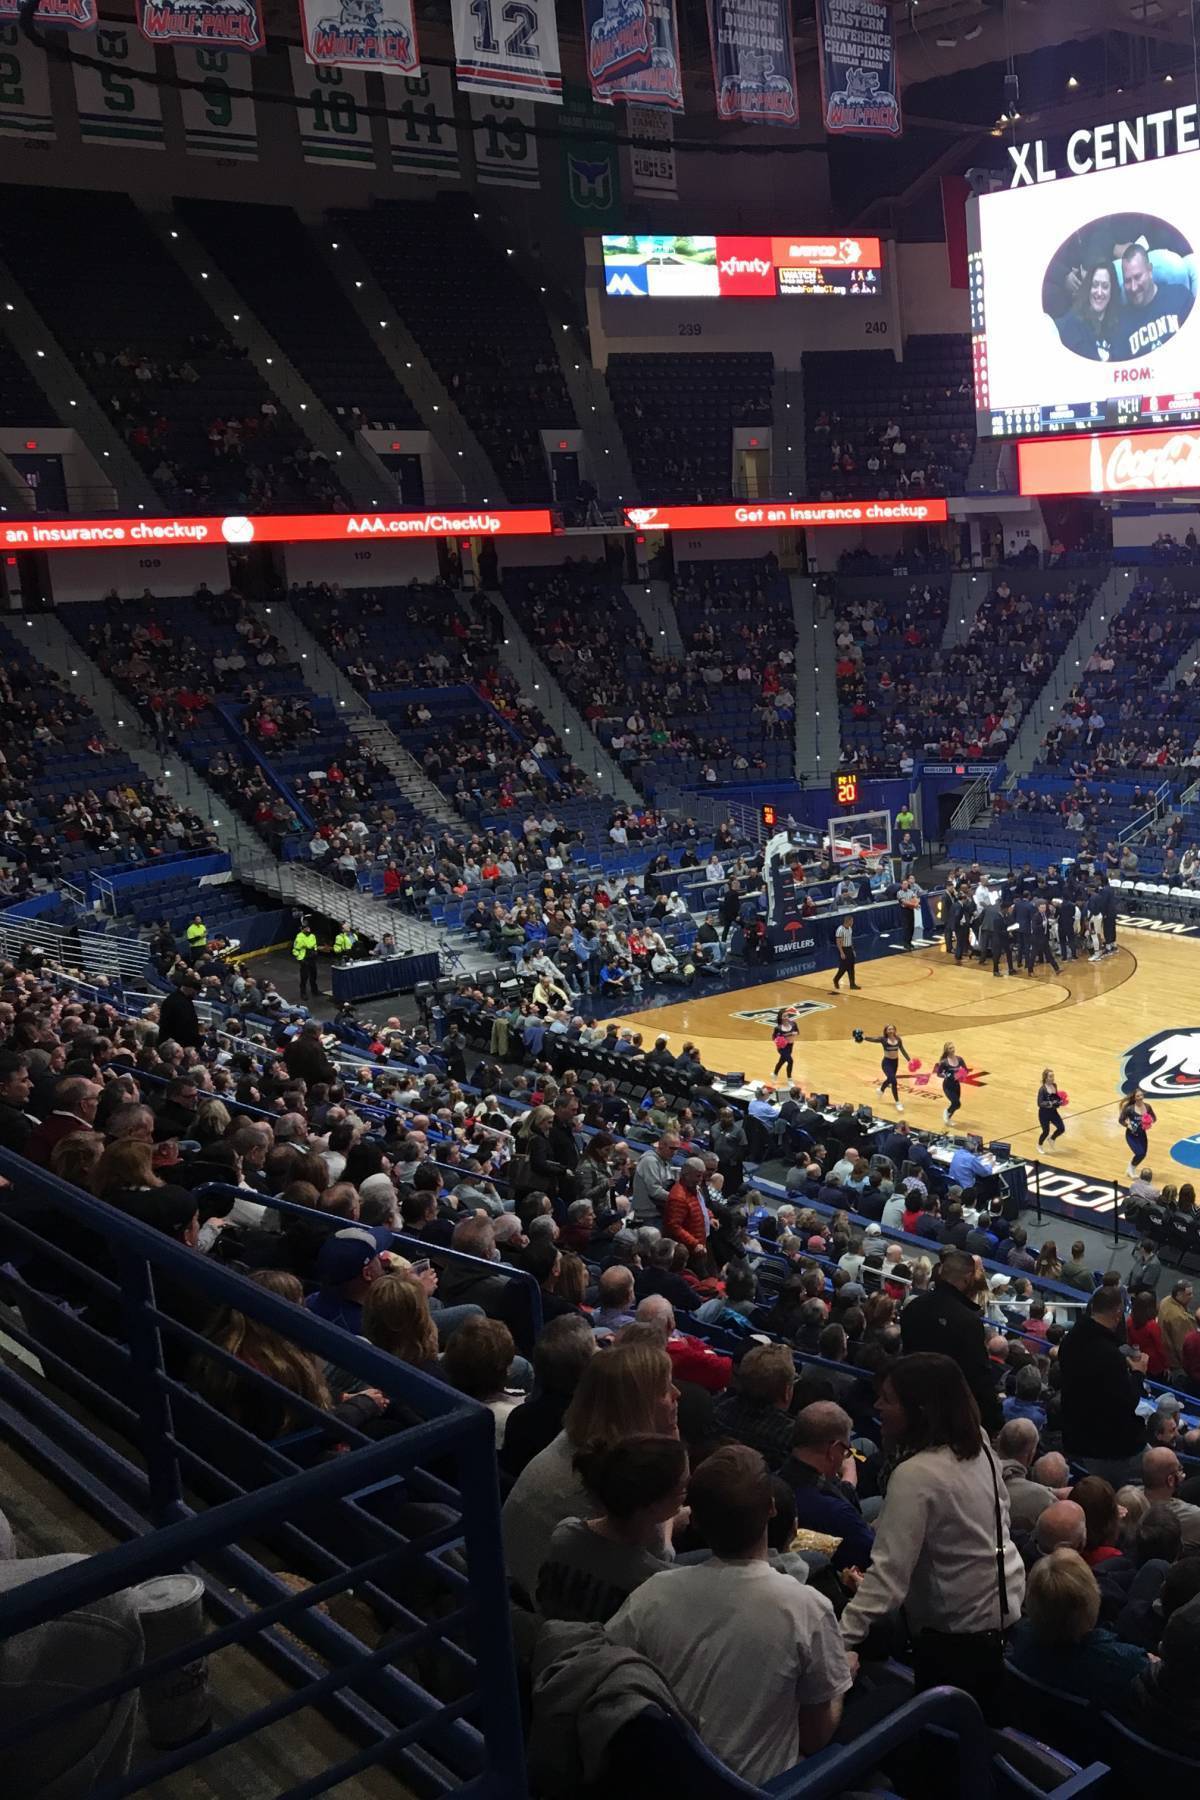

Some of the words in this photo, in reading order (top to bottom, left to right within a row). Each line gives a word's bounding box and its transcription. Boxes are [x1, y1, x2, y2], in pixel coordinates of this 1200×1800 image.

[201, 14, 252, 41] PACK
[470, 0, 540, 58] 12
[724, 12, 775, 32] DIVISION
[831, 11, 885, 31] EASTERN
[718, 28, 783, 52] CHAMPIONS
[823, 24, 892, 47] CONFERENCE
[824, 39, 891, 62] CHAMPIONS
[1008, 140, 1056, 188] XL
[720, 256, 771, 277] xfinity
[782, 270, 817, 281] WATCH
[677, 323, 702, 335] 239
[864, 320, 888, 334] 240
[1128, 314, 1182, 355] UCONN
[735, 507, 763, 522] Get
[768, 509, 787, 521] an
[790, 506, 862, 520] insurance
[865, 504, 928, 519] checkup
[5, 529, 28, 543] an
[33, 525, 126, 541] insurance
[130, 522, 208, 540] checkup
[346, 515, 501, 534] AAA.com/CheckUp
[139, 558, 161, 568] 109
[354, 551, 371, 560] 110
[838, 785, 855, 802] 20
[773, 938, 815, 954] TRAVELERS
